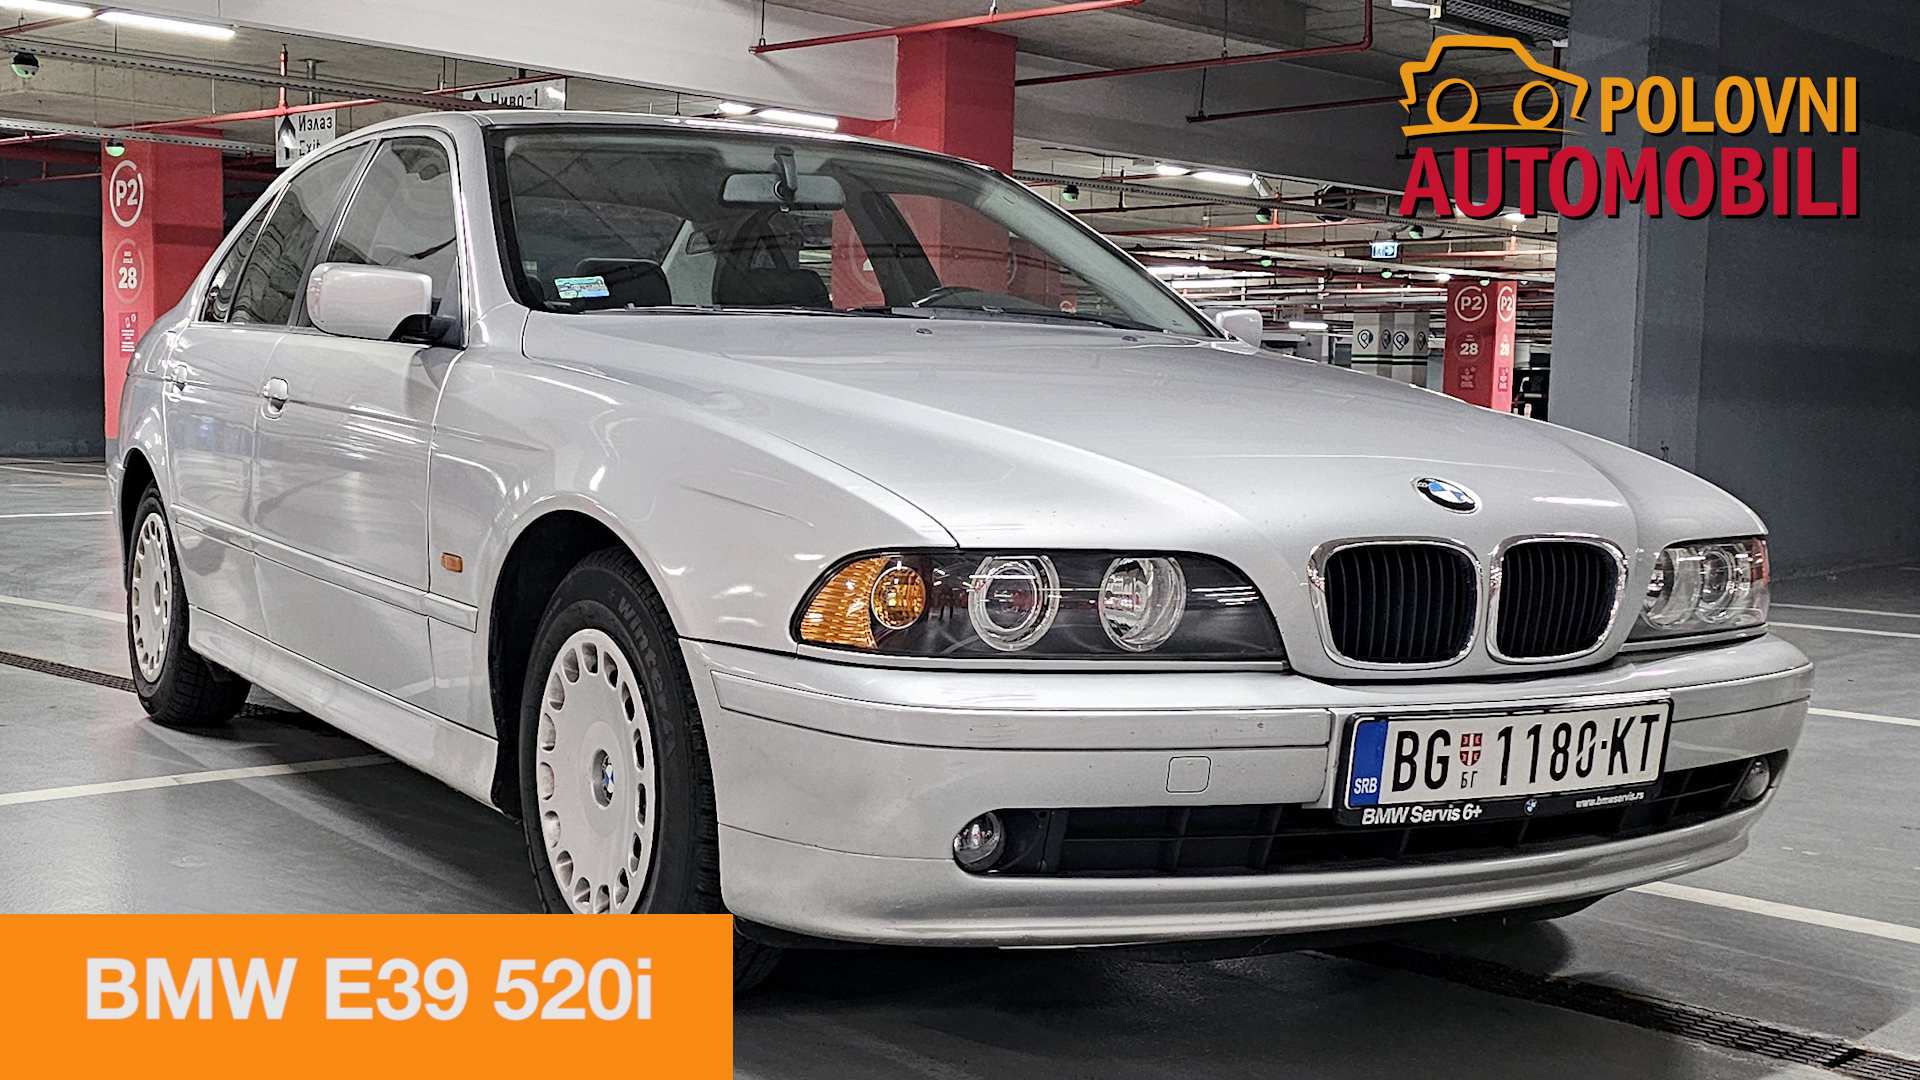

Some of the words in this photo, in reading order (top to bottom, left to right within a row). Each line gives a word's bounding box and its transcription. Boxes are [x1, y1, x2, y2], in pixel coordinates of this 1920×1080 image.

[299, 115, 333, 131] Излаз
[116, 178, 139, 207] P2
[118, 266, 138, 289] 28
[1460, 295, 1482, 311] P2
[1500, 295, 1513, 312] P2
[1460, 342, 1479, 356] 28
[1500, 342, 1510, 356] 28
[1391, 728, 1451, 793] BG
[1353, 777, 1378, 794] SRB
[1460, 770, 1478, 789] БГ
[1361, 806, 1410, 825] BMW
[1409, 804, 1461, 823] Servis
[1462, 803, 1483, 820] 6+
